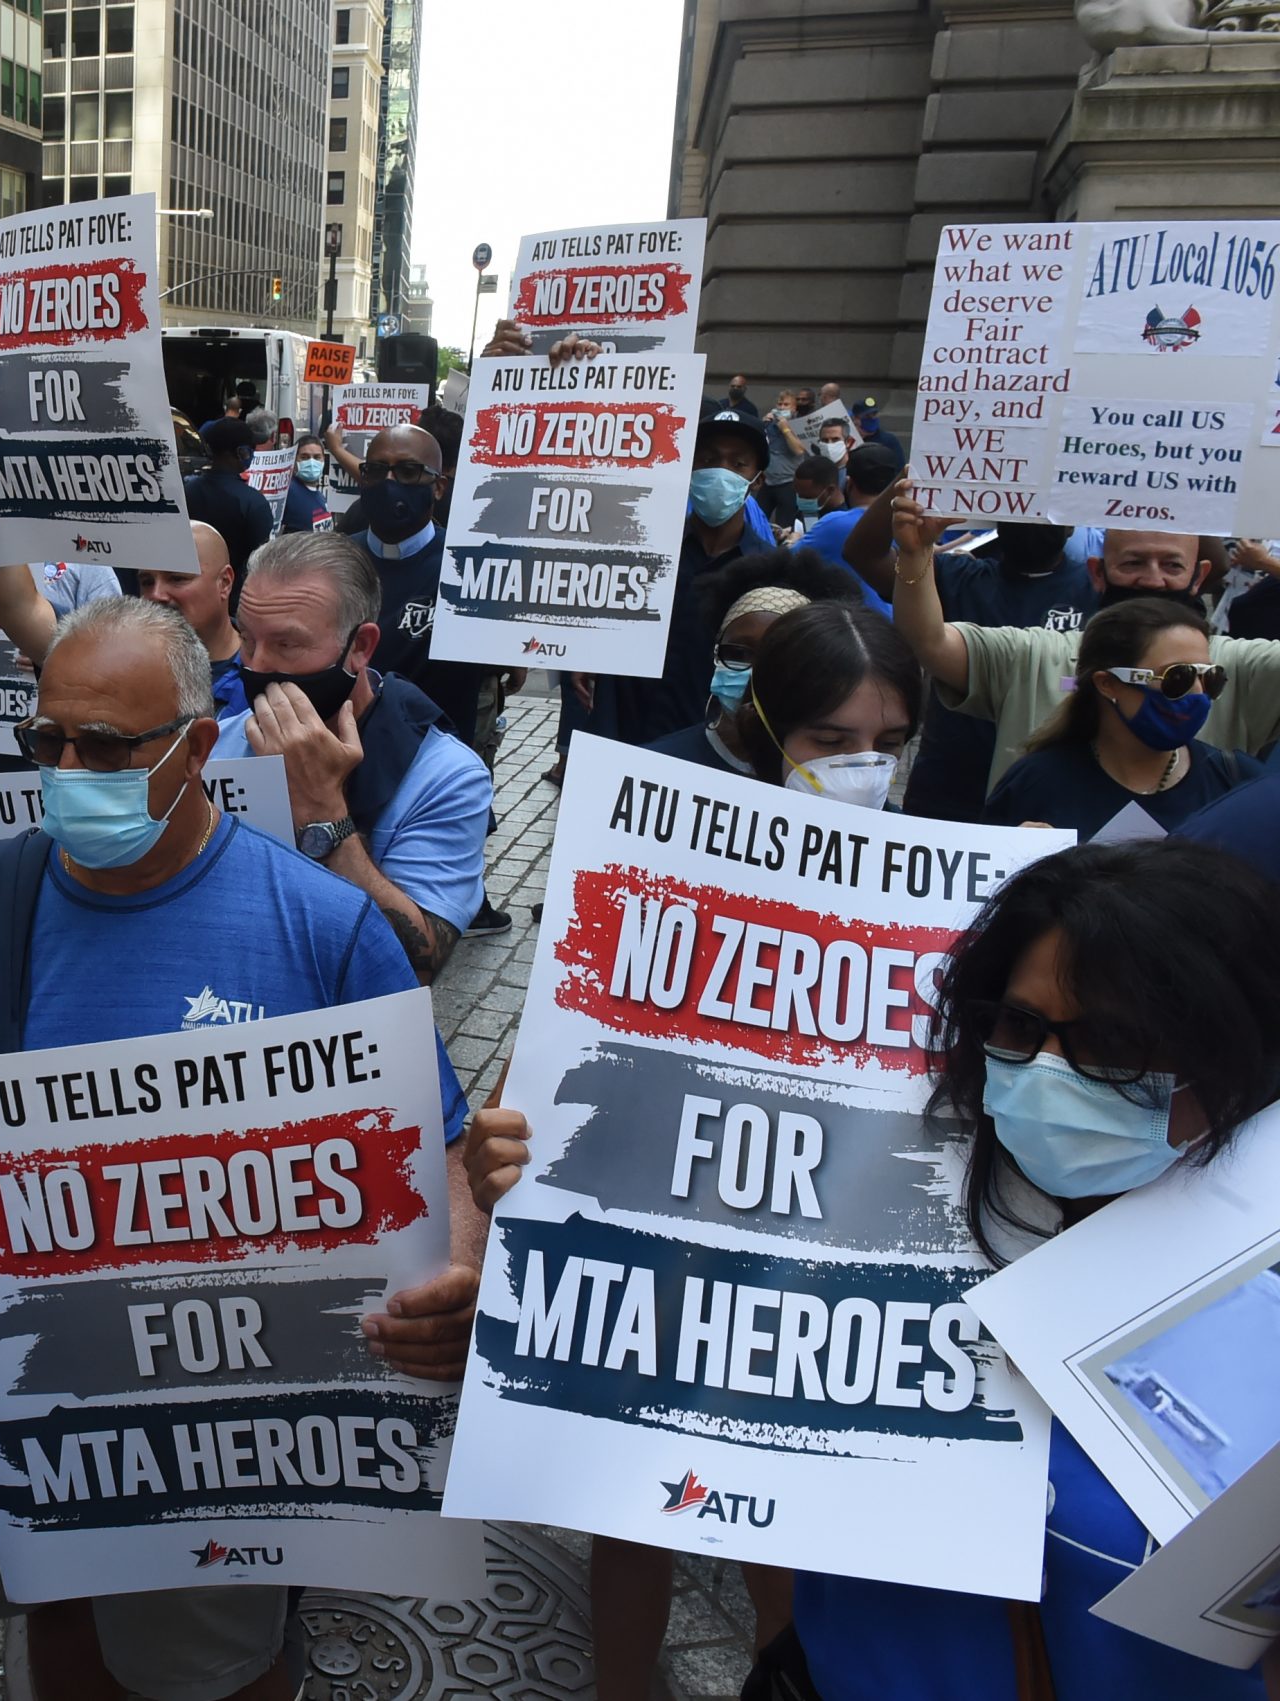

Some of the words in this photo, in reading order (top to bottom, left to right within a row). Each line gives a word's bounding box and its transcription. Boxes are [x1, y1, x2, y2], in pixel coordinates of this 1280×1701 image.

[20, 223, 53, 254] TELLS
[58, 218, 84, 248] PAT
[88, 211, 132, 245] FOYE:
[532, 240, 558, 260] ATU
[561, 236, 601, 258] TELLS
[607, 234, 634, 256] PAT
[639, 231, 682, 254] FOYE:
[945, 228, 993, 251] We
[1003, 228, 1073, 250] want
[944, 261, 1011, 282] what
[1022, 264, 1063, 281] we
[1086, 234, 1150, 298] ATU
[1150, 230, 1220, 288] Local
[1220, 234, 1280, 300] 1056
[28, 273, 121, 332] ZEROES
[533, 281, 566, 315] NO
[569, 274, 666, 314] ZEROES
[943, 289, 1053, 312] deserve
[964, 318, 1023, 341] Fair
[310, 347, 350, 364] RAISE
[933, 344, 1048, 364] contract
[308, 364, 348, 379] PLOW
[491, 366, 523, 392] ATU
[530, 366, 578, 391] TELLS
[584, 366, 618, 390] PAT
[622, 366, 676, 391] FOYE:
[918, 370, 968, 392] and
[974, 368, 1071, 392] hazard
[28, 371, 85, 422] FOR
[343, 389, 357, 399] ATU
[359, 389, 381, 399] TELLS
[383, 388, 397, 399] PAT
[347, 408, 365, 426] NO
[366, 408, 411, 427] ZEROES
[922, 398, 980, 422] pay,
[991, 395, 1044, 419] and
[1091, 407, 1137, 427] You
[1142, 410, 1182, 427] call
[1191, 412, 1226, 431] US
[494, 413, 538, 457] NO
[538, 412, 654, 459] ZEROES
[952, 428, 1005, 452] WE
[1062, 436, 1146, 461] Heroes,
[1154, 440, 1192, 460] but
[1201, 446, 1242, 465] you
[45, 455, 161, 503] HEROES
[924, 455, 1028, 482] WANT
[1057, 469, 1138, 488] reward
[1146, 471, 1179, 490] US
[1186, 473, 1237, 494] with
[528, 489, 593, 533] FOR
[952, 489, 1042, 517] NOW.
[1104, 500, 1176, 521] Zeros.
[87, 541, 112, 554] ATU
[460, 557, 523, 603] MTA
[530, 561, 648, 610] HEROES
[536, 642, 567, 657] ATU
[610, 777, 678, 843] ATU
[690, 795, 788, 872] TELLS
[798, 823, 870, 888] PAT
[609, 895, 697, 1011] NO
[696, 915, 963, 1050] ZEROES
[210, 1000, 264, 1024] ATU
[36, 1063, 162, 1123] TELLS
[176, 1052, 248, 1107] PAT
[263, 1031, 381, 1098] FOYE:
[670, 1093, 823, 1219] FOR
[105, 1139, 363, 1248] ZEROES
[127, 1298, 271, 1378] FOR
[513, 1250, 657, 1377] MTA
[675, 1277, 976, 1413] HEROES
[22, 1427, 168, 1505] MTA
[171, 1415, 422, 1493] HEROES
[697, 1490, 776, 1529] ATU
[224, 1547, 284, 1567] ATU
